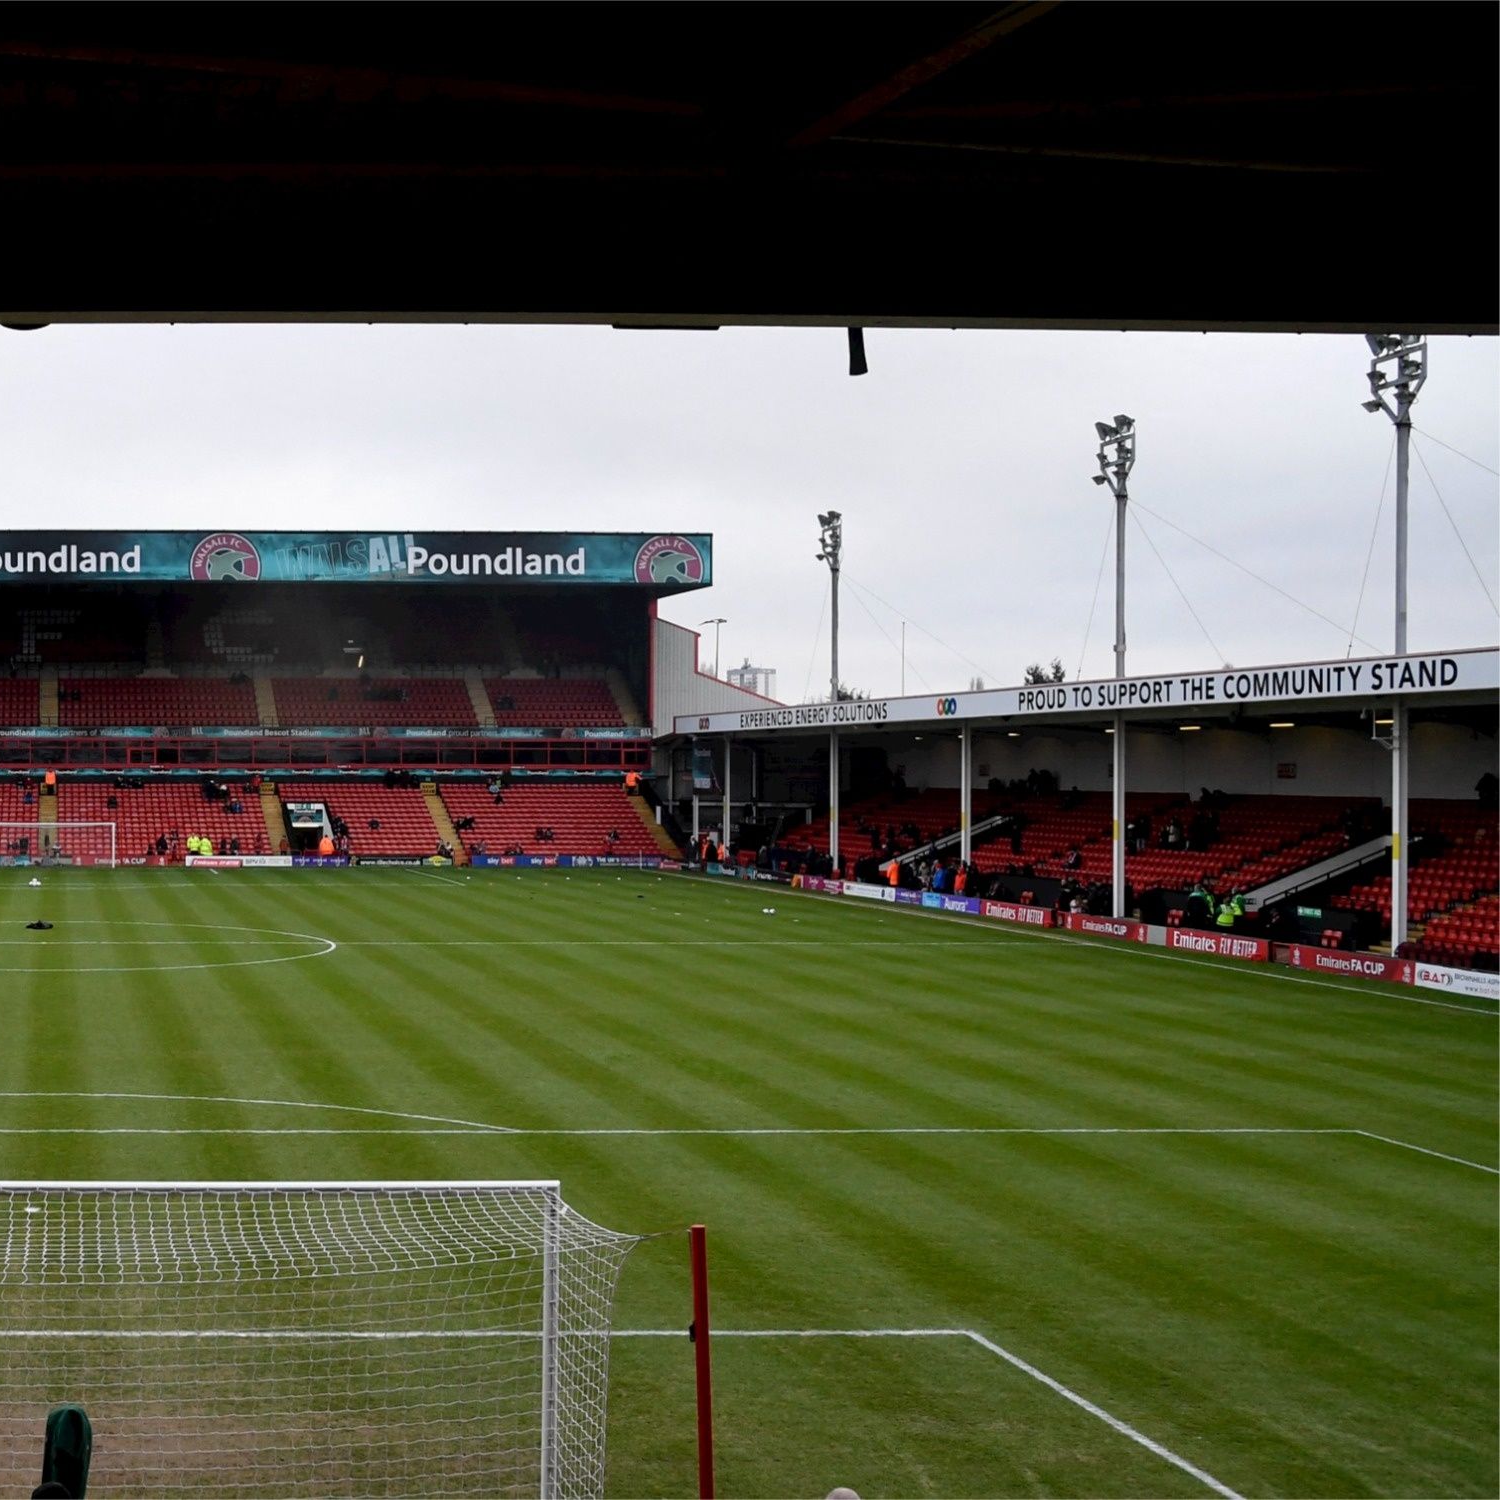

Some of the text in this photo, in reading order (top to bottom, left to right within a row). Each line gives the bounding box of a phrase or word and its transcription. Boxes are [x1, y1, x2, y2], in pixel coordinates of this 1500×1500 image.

[194, 536, 243, 568] WALSALL FC
[408, 546, 585, 576] Poundland
[638, 538, 685, 569] WALSALL FC
[1018, 658, 1458, 711] PROUD TO SUPPORT THE COMMUNITY STAND
[740, 703, 888, 729] EXPERIENCED ENERGY SOLUTIONS
[487, 857, 513, 866] sky bet
[530, 857, 543, 866] sky
[985, 902, 1016, 921] Emirates
[1027, 909, 1044, 925] BETTER
[1082, 919, 1127, 936] Emirates FA CUP
[1173, 931, 1257, 958] Emirates FLY BETTER
[1316, 954, 1385, 976] Emirates FA CUP
